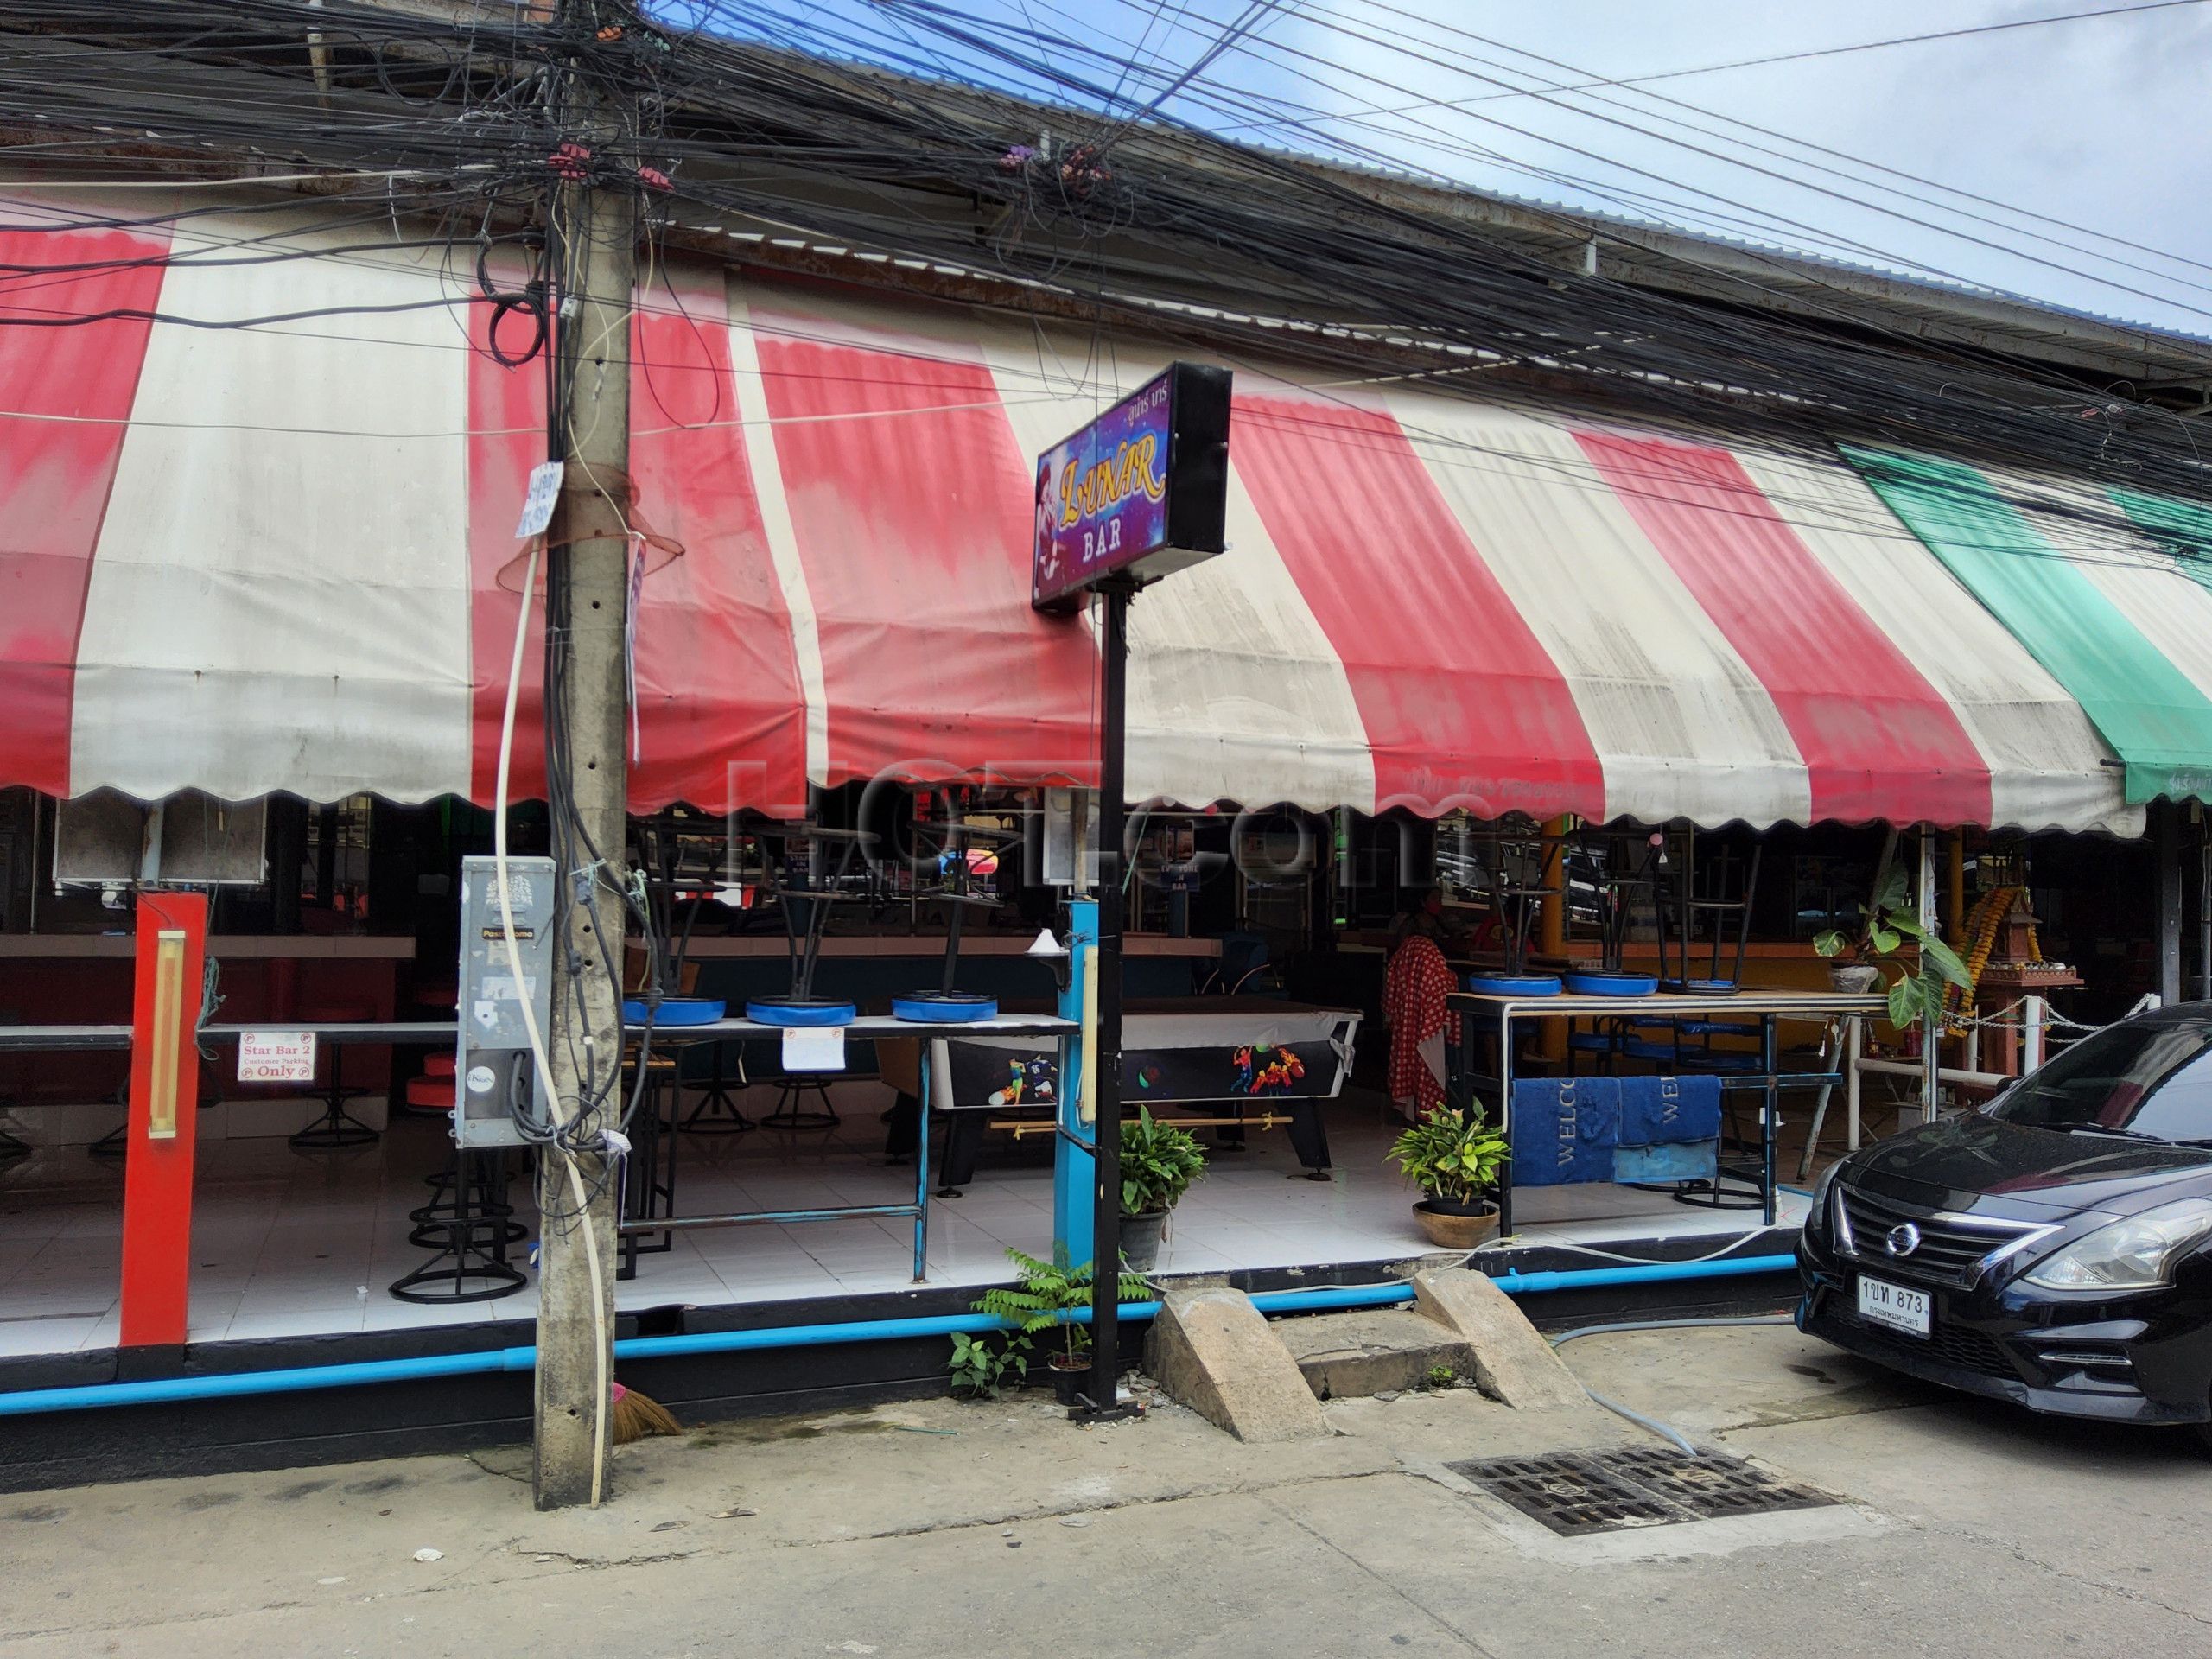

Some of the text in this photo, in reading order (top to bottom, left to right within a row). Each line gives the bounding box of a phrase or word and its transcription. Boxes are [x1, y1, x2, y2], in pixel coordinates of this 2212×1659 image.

[1152, 378, 1167, 407] บาร์
[1059, 432, 1166, 530] LUNAR
[1083, 518, 1122, 563] BAR
[1160, 864, 1198, 873] EVYONE
[244, 1046, 310, 1055] Star Bar 2
[257, 1065, 295, 1078] Only
[1897, 1291, 1923, 1313] 873
